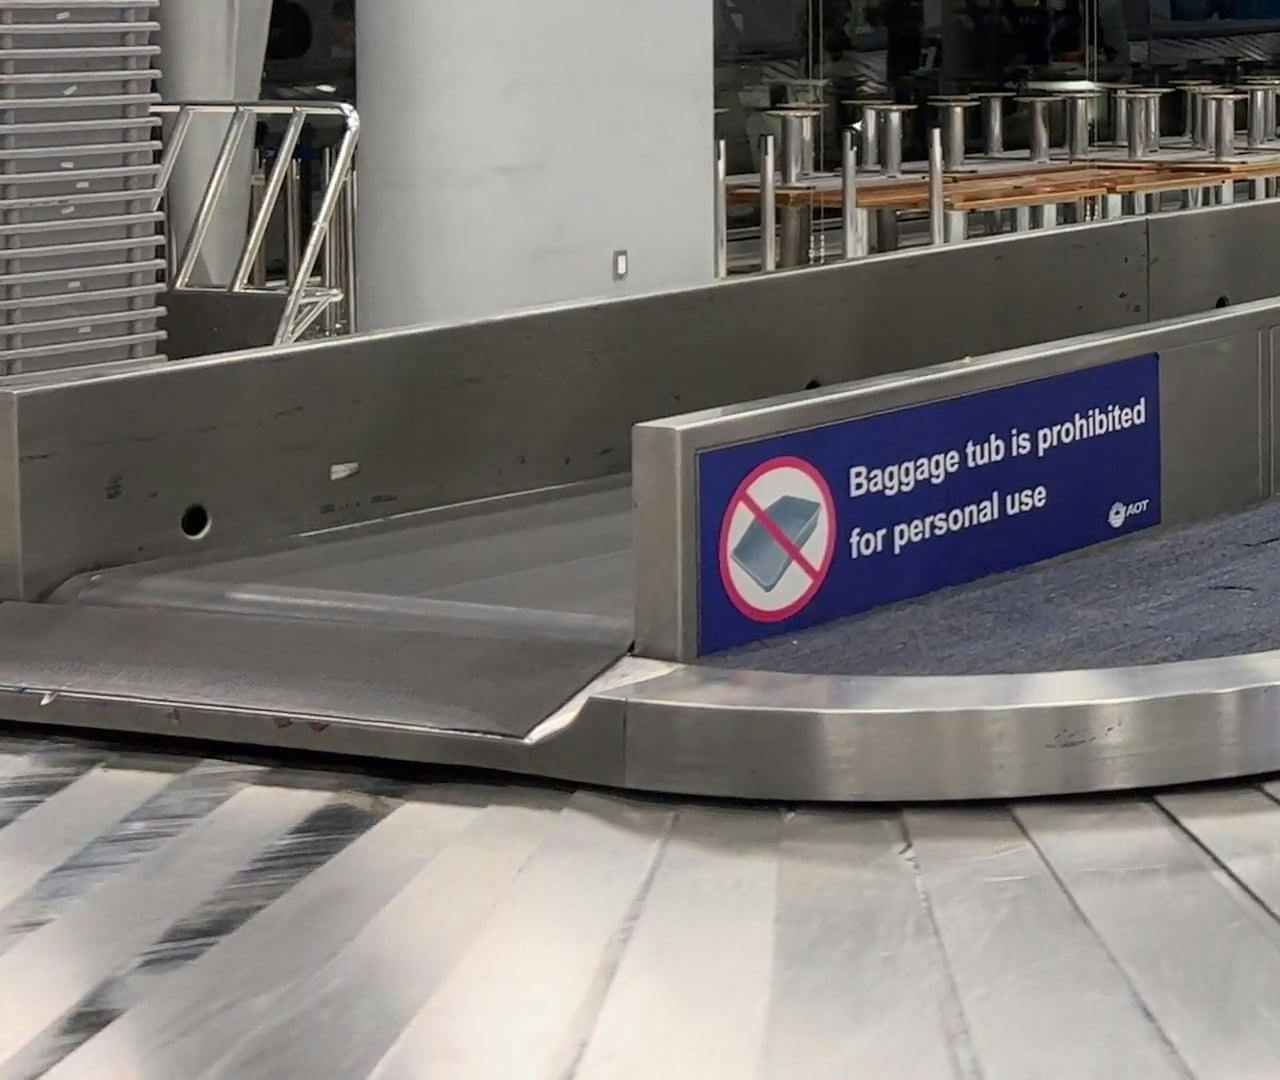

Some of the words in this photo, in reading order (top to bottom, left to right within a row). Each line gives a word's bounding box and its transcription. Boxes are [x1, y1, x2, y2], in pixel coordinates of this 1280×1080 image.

[848, 450, 960, 498] Baggage
[964, 433, 1006, 469] tub
[1011, 428, 1032, 458] is
[1037, 396, 1147, 457] prohibited
[848, 526, 888, 560] for
[892, 490, 1000, 555] personal
[1005, 484, 1048, 516] use
[1123, 498, 1150, 517] AOT
